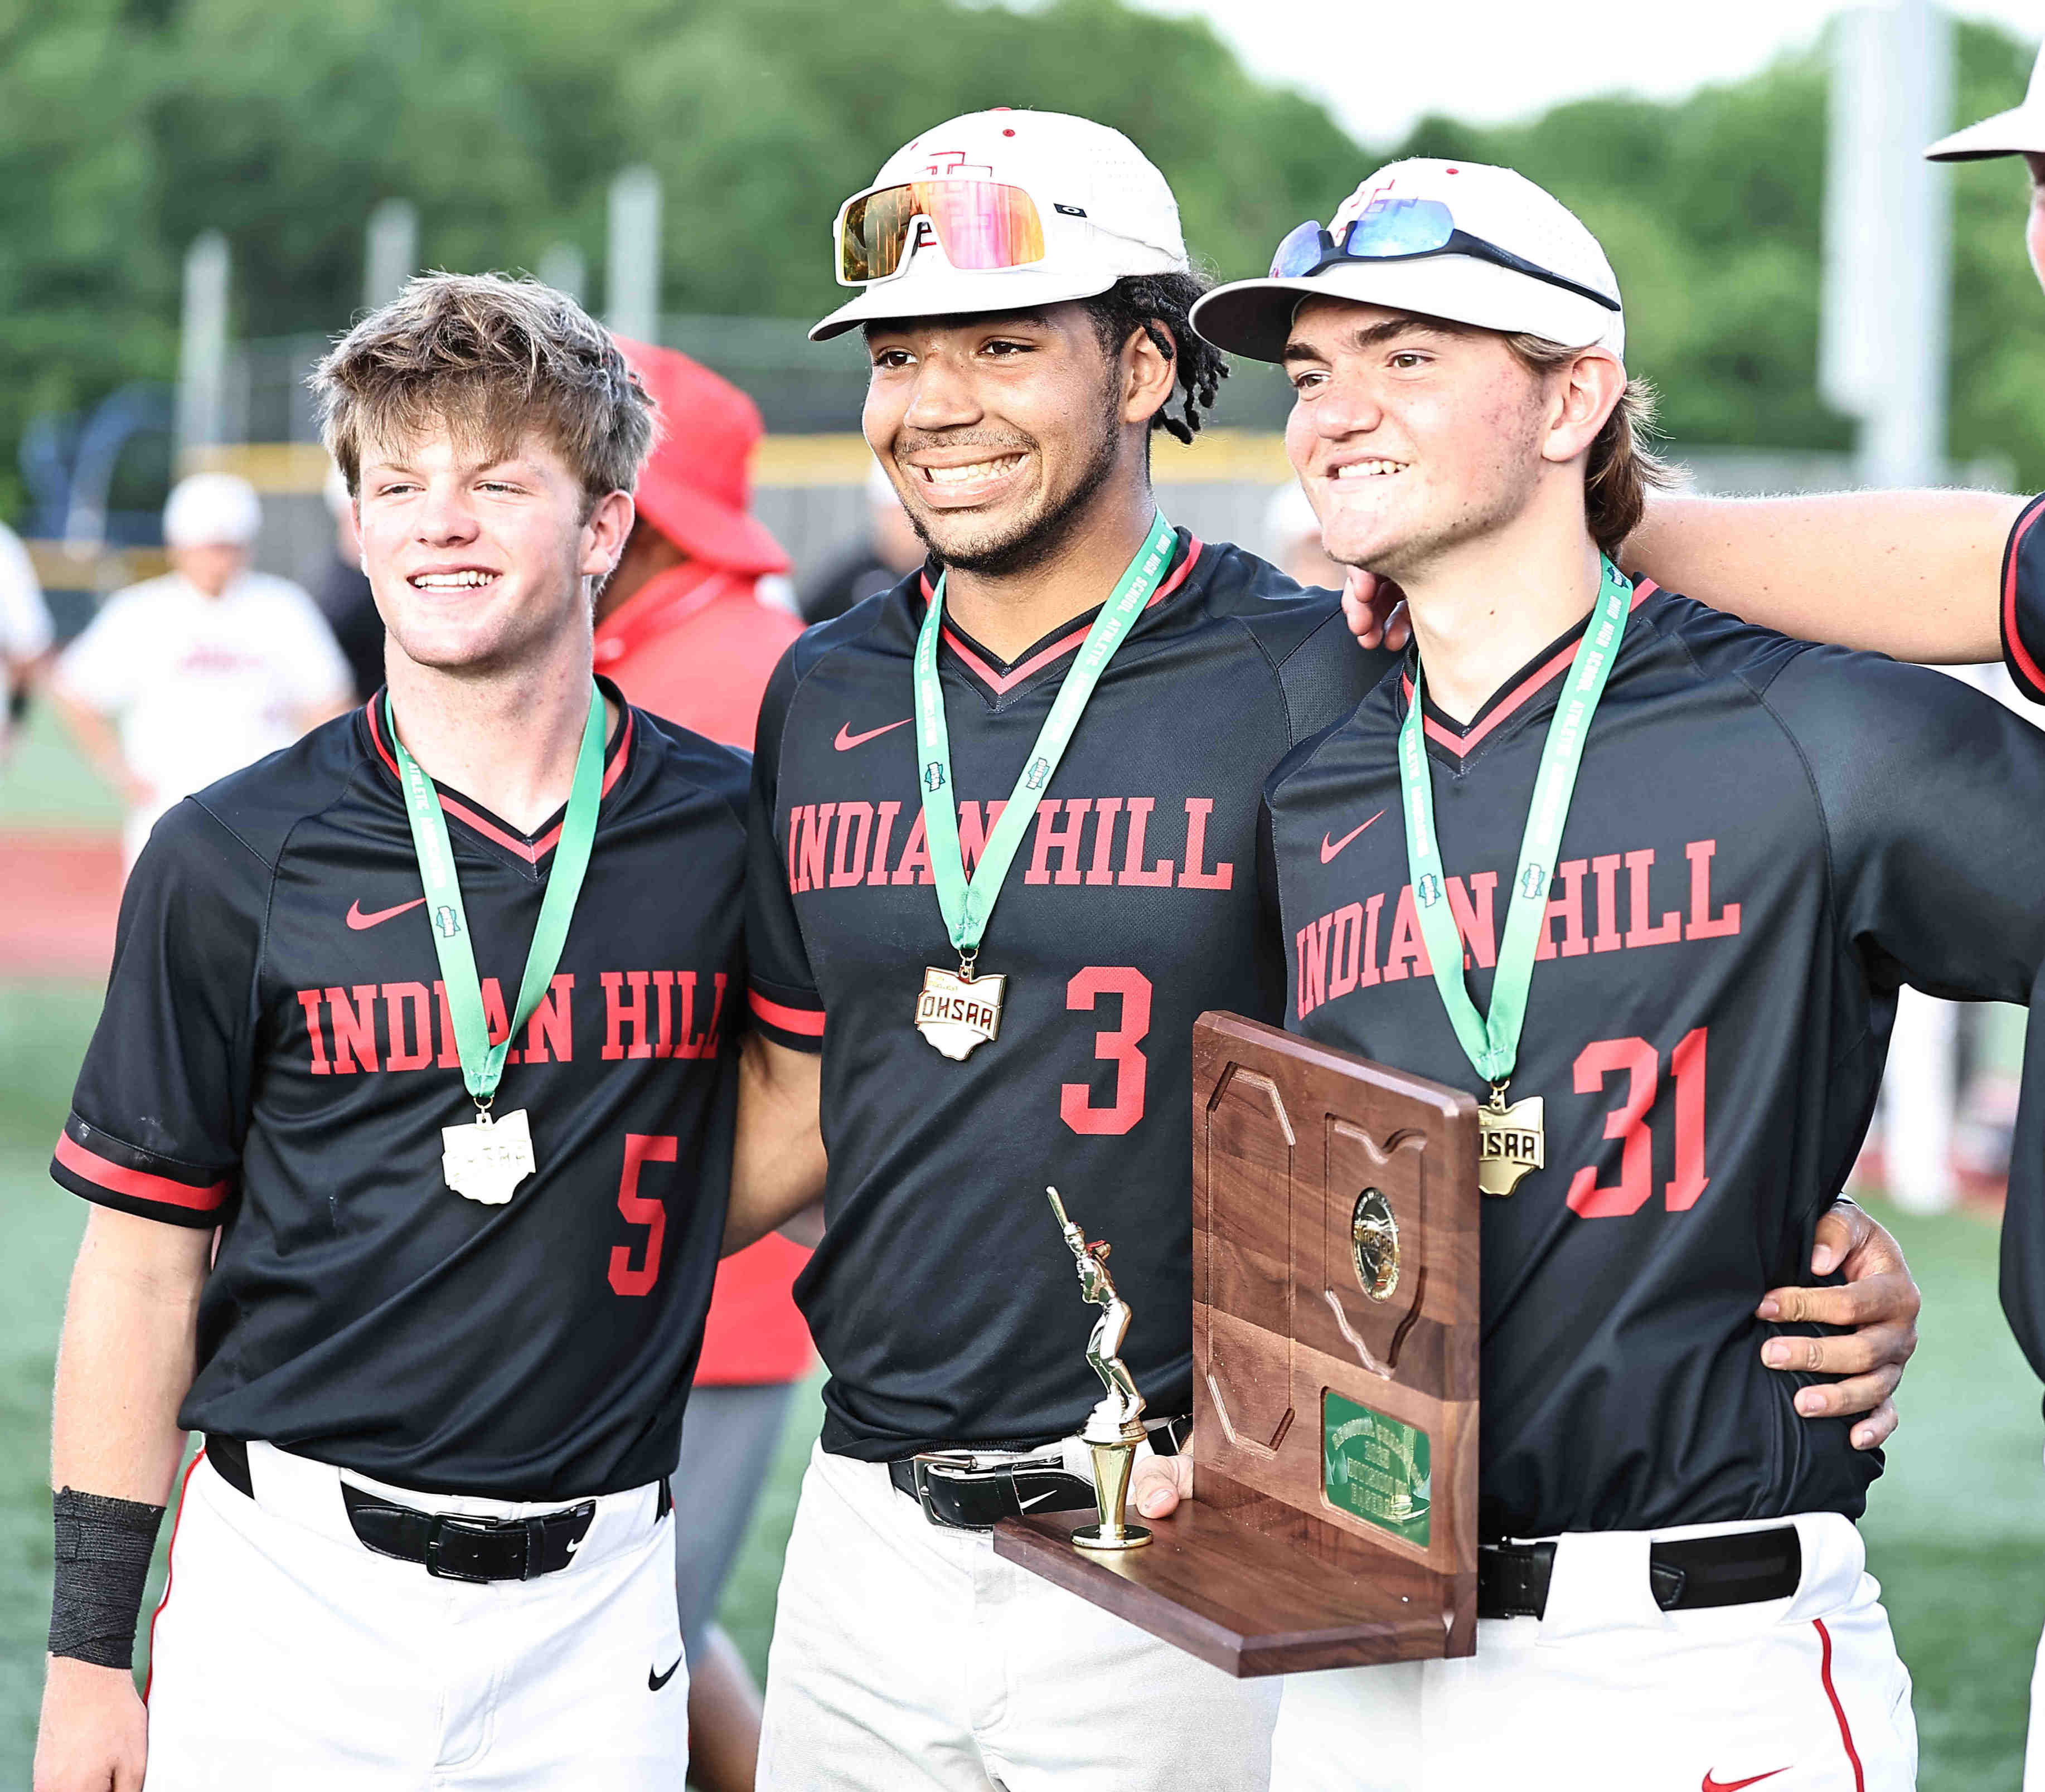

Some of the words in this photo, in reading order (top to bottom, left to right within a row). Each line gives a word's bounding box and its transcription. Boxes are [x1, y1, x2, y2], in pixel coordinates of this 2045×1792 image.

[1117, 576, 1148, 613] SCHOOL
[1142, 552, 1161, 577] HIGH
[1025, 798, 1234, 890] HILL
[1534, 839, 1741, 961] HILL
[600, 970, 727, 1060] HILL
[922, 995, 994, 1031] OHSAA
[1060, 967, 1152, 1135] 3
[1566, 1027, 1710, 1219] 31
[608, 1133, 678, 1296] 5
